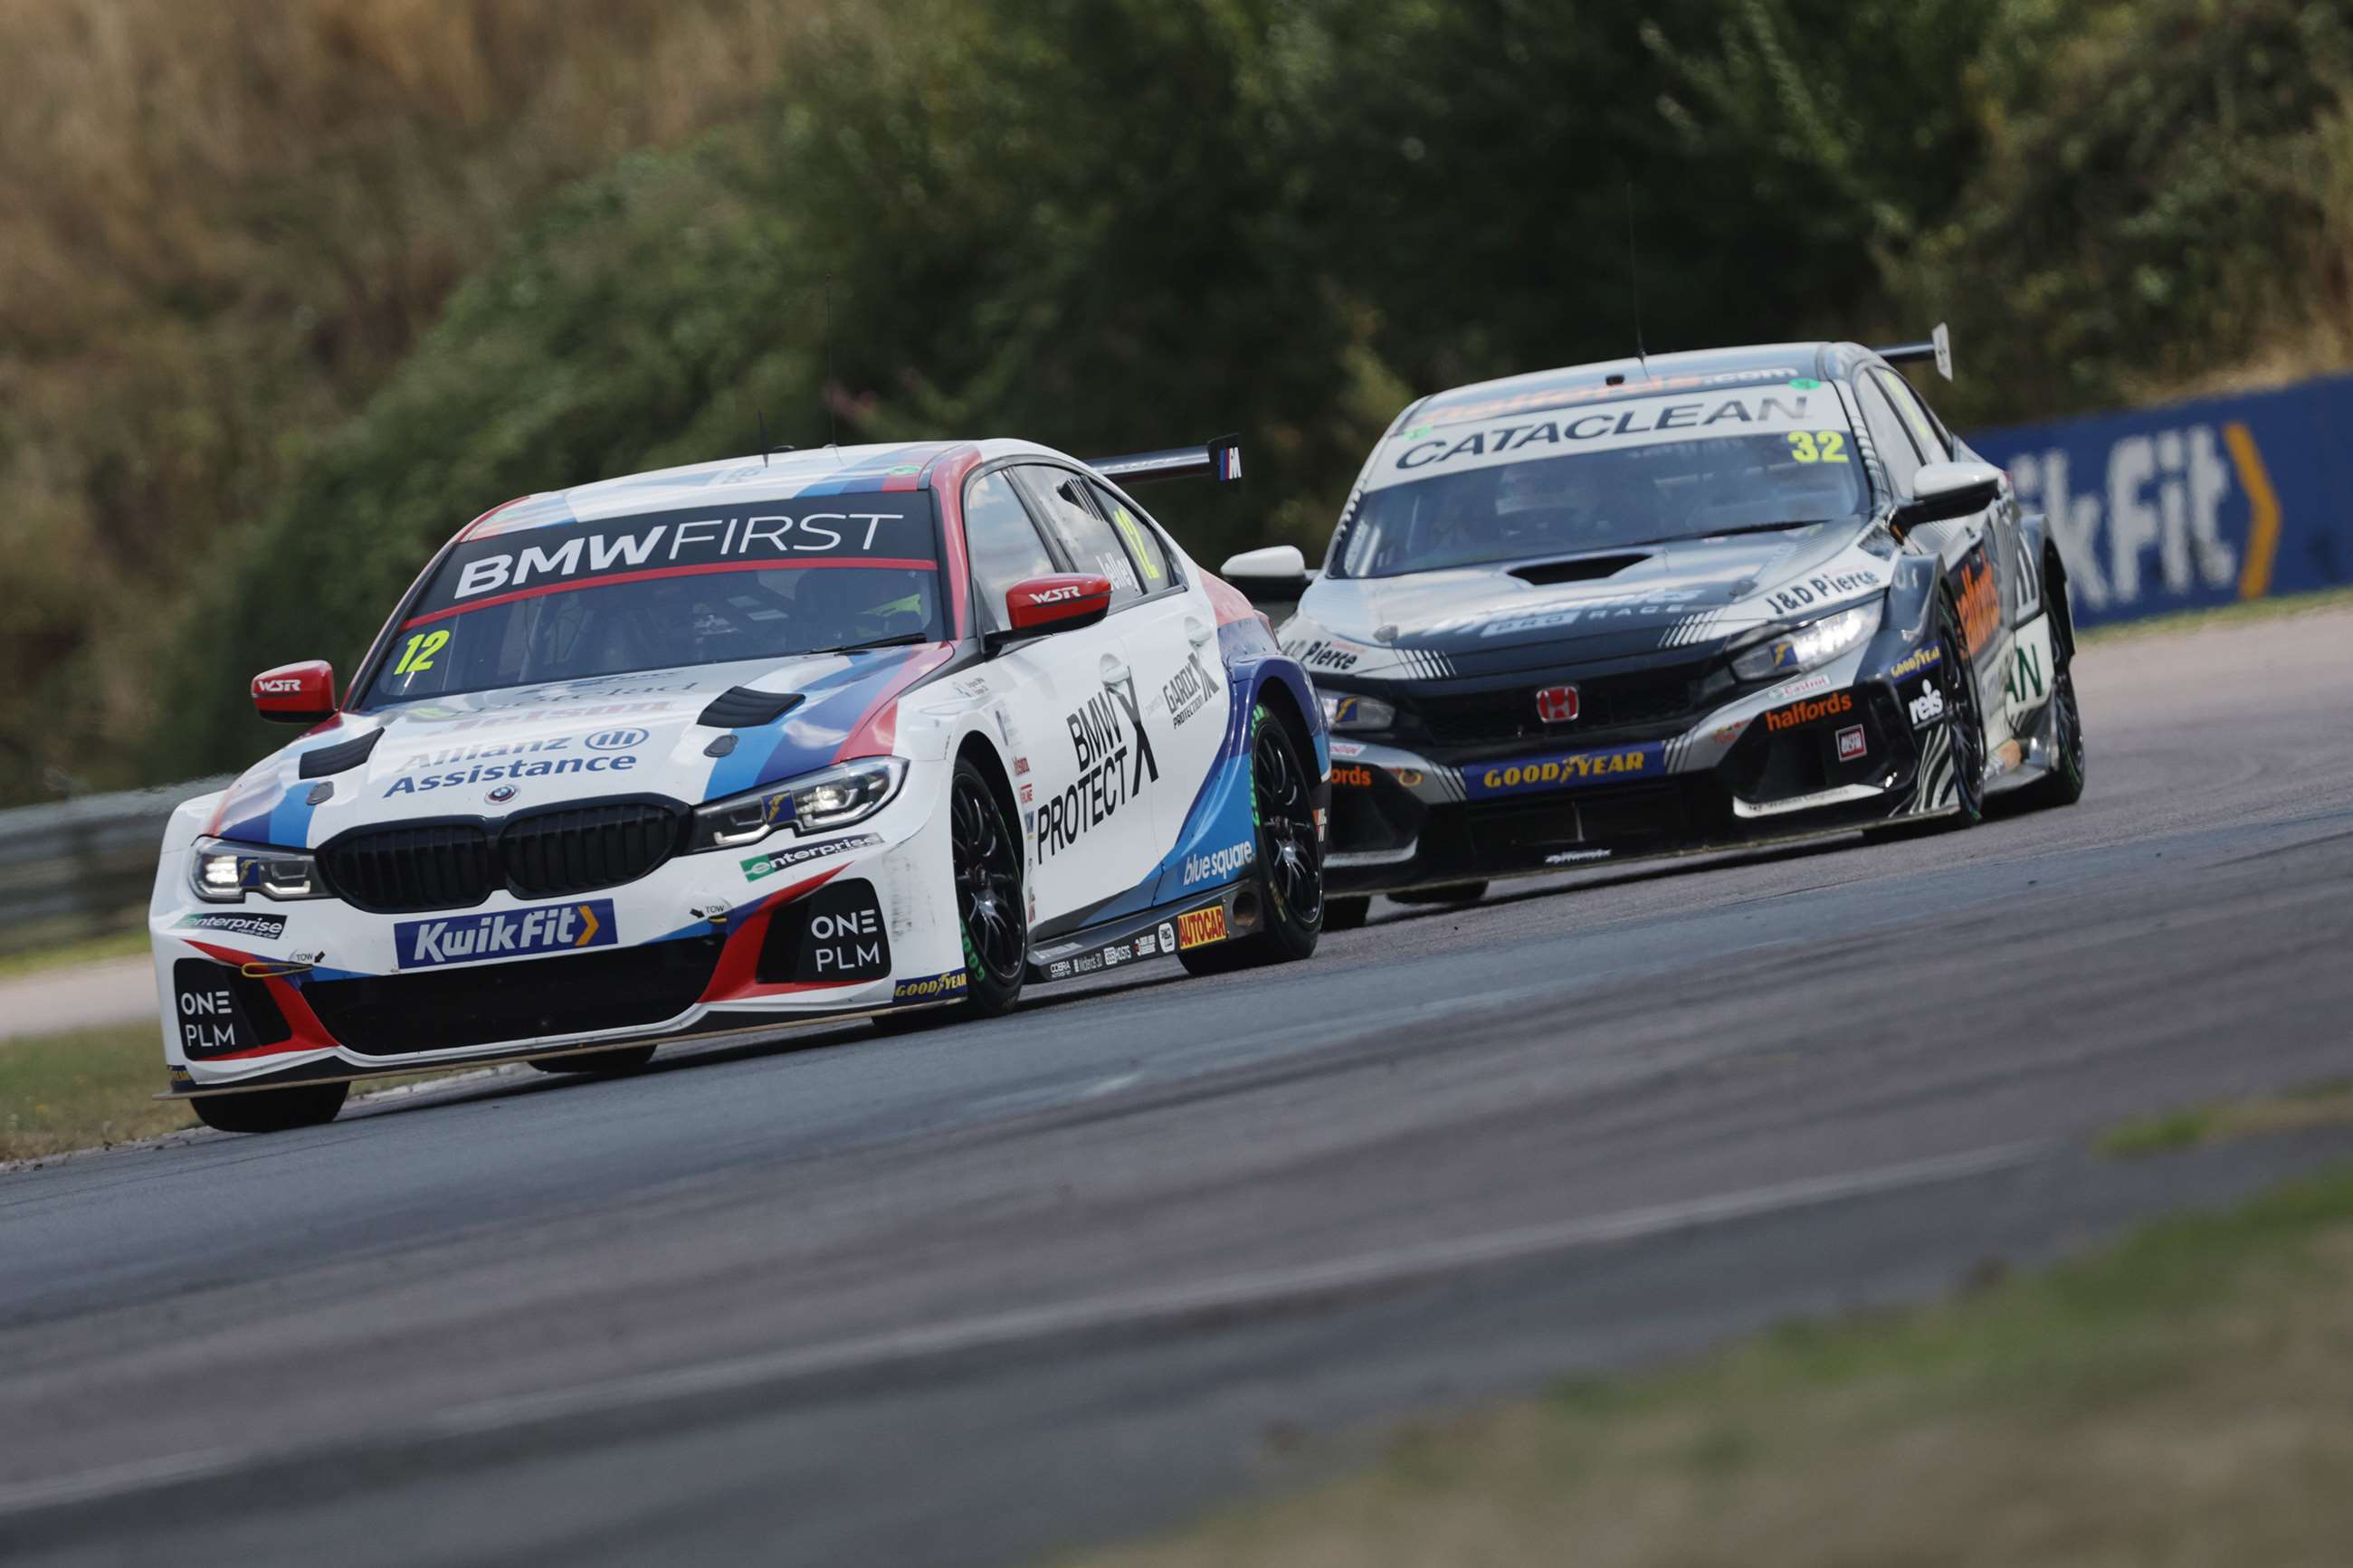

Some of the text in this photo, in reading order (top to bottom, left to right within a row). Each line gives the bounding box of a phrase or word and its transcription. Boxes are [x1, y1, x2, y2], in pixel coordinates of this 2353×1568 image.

[1395, 396, 1809, 470] CATACLEAN
[1786, 430, 1849, 464] 32
[1766, 570, 1880, 615] J&D Pierce
[394, 629, 451, 675] 12
[1301, 641, 1358, 670] Pierce
[1766, 691, 1853, 732] halfords
[1909, 679, 1944, 725] reis
[1066, 687, 1122, 774] BMW
[398, 736, 573, 774] Allianz
[1483, 752, 1645, 788] GOODYEAR
[382, 755, 637, 799] Assistance
[1037, 745, 1129, 866] PROTECT
[750, 833, 881, 876] enterprise
[185, 916, 283, 935] enterprise
[706, 905, 725, 915] TOW
[811, 908, 878, 940] ONE
[1178, 908, 1226, 946] AUTOCAR
[296, 953, 314, 962] TOW
[814, 945, 881, 973] PLM
[181, 991, 233, 1015] ONE
[895, 973, 967, 997] GOODYEAR
[185, 1022, 236, 1047] PLM
